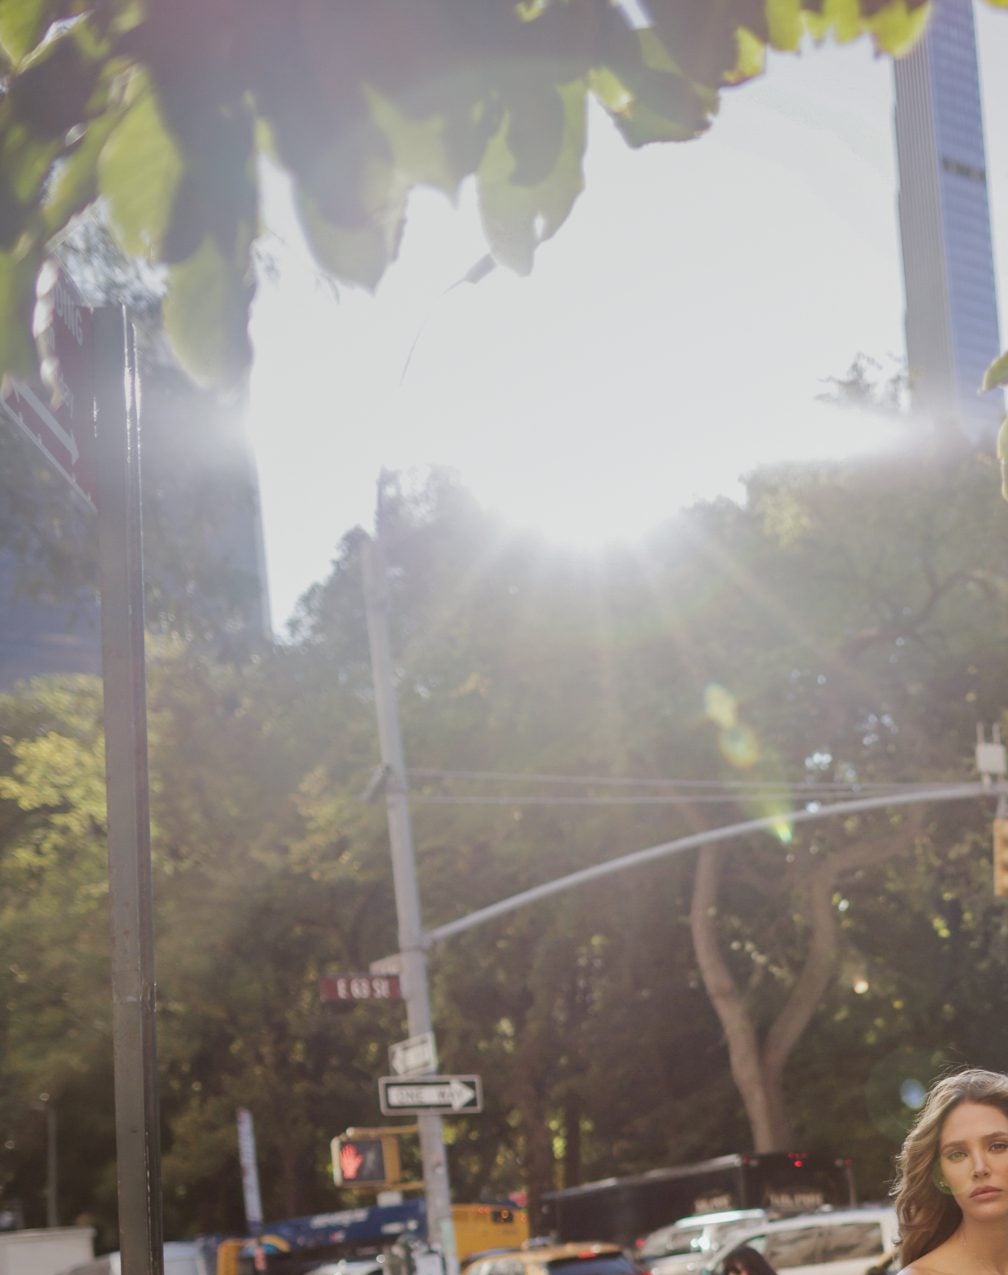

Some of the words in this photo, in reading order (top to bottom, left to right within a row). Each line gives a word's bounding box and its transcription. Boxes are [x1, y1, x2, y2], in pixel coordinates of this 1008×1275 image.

[336, 977, 348, 999] E
[398, 1088, 424, 1102] ONE
[436, 1086, 463, 1101] WAY
